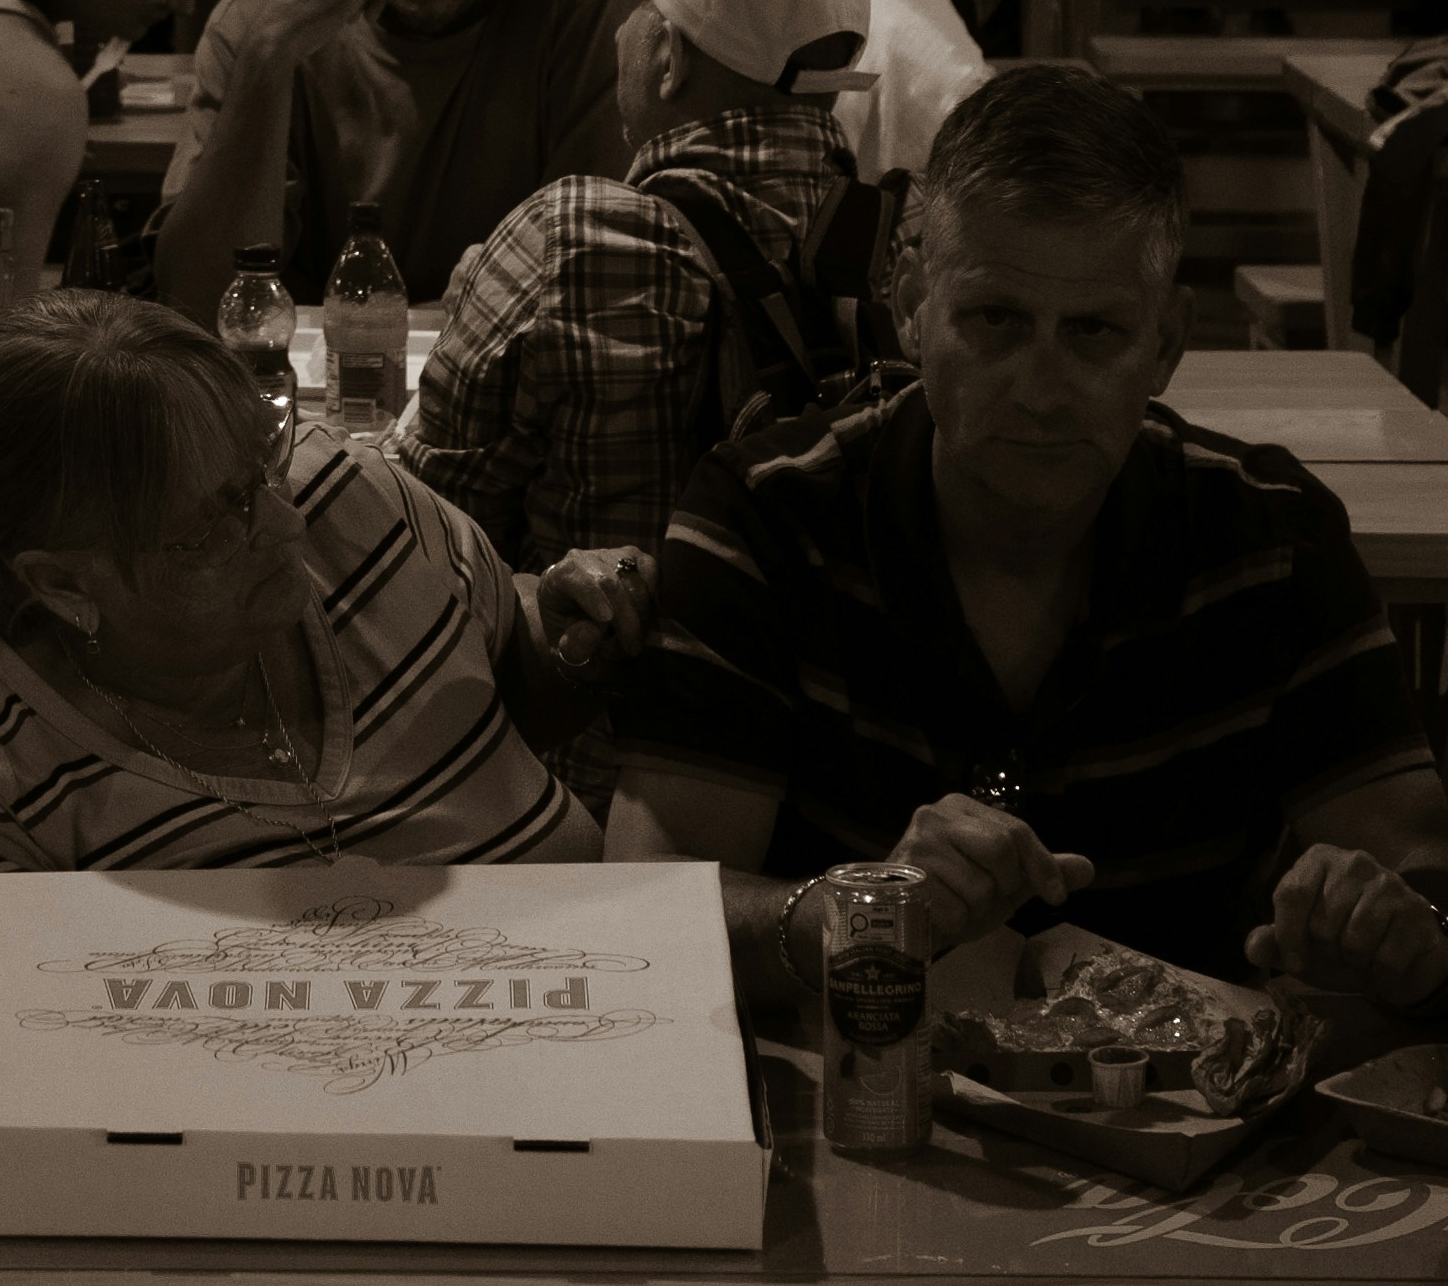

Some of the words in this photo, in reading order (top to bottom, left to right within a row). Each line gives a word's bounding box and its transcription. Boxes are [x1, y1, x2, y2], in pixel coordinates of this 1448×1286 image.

[102, 976, 313, 1012] NOVA
[343, 975, 591, 1012] PIZZA
[858, 1021, 888, 1033] ROSSA
[236, 1161, 339, 1202] PIZZA
[350, 1164, 440, 1205] NOVA
